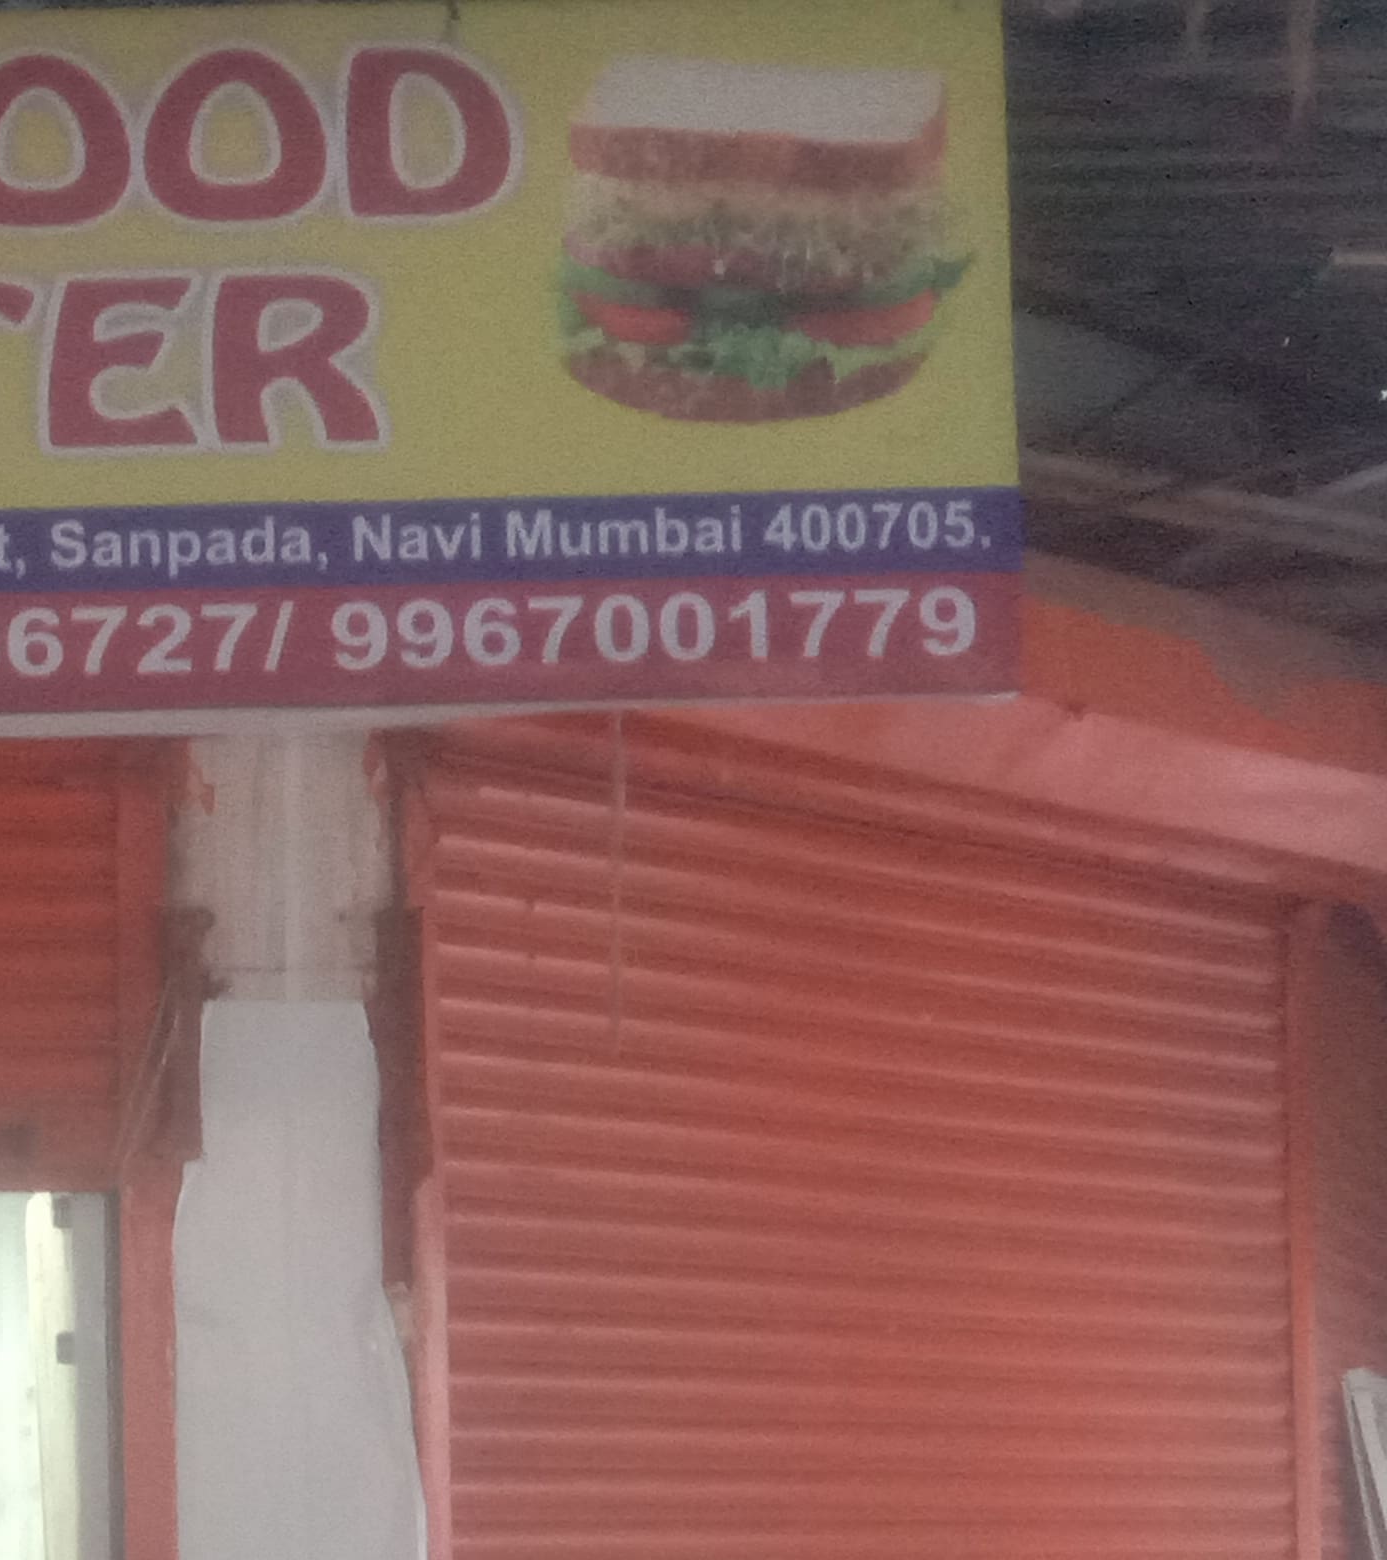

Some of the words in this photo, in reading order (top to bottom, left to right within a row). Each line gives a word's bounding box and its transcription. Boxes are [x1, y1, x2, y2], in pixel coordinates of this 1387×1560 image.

[49, 516, 328, 580] Sanpada,
[351, 511, 483, 563] Navi
[504, 505, 741, 560] Mumbai
[764, 500, 992, 552] 400705.
[330, 584, 977, 670] 9967001779
